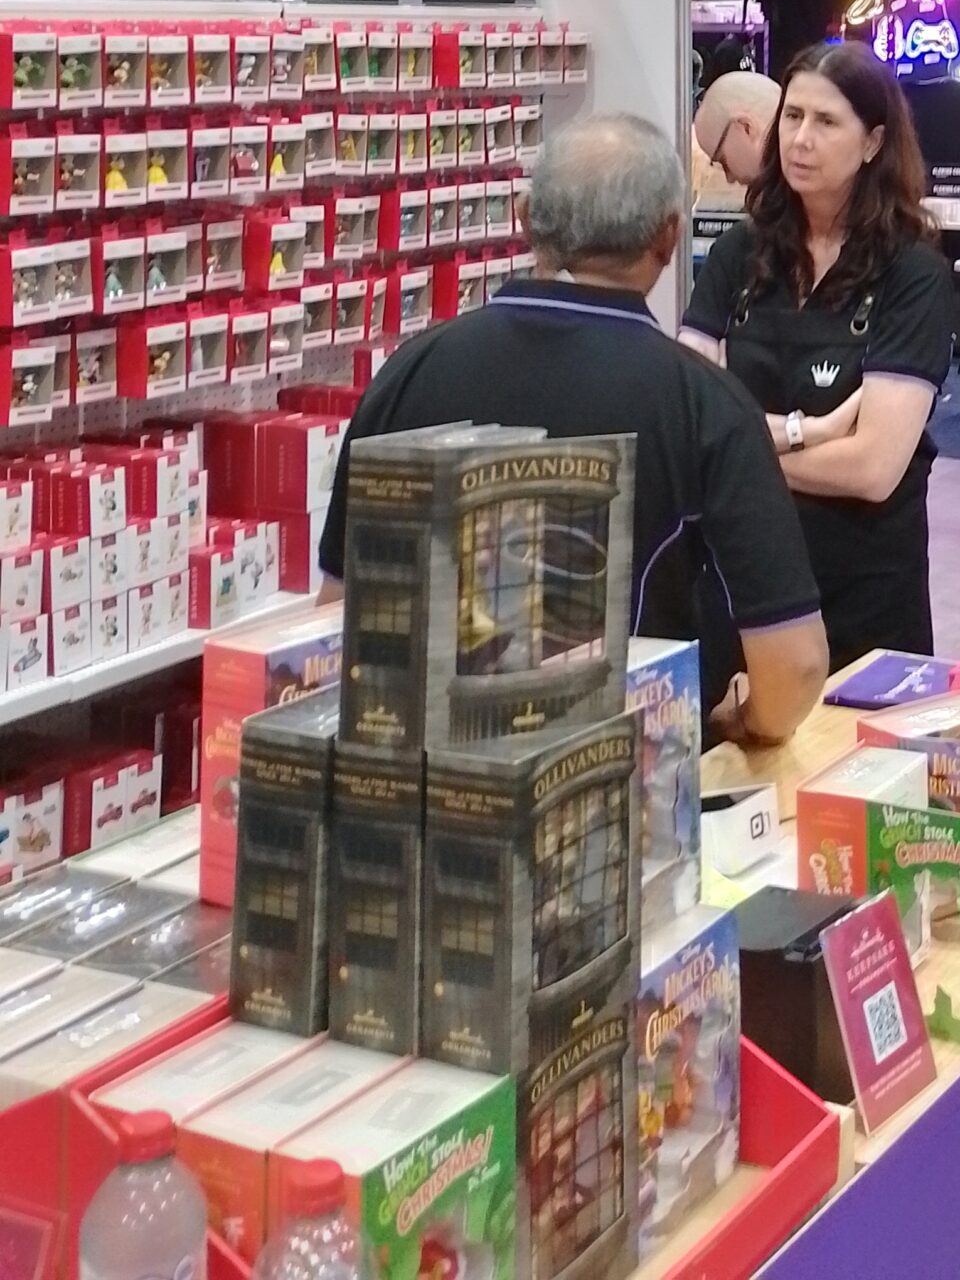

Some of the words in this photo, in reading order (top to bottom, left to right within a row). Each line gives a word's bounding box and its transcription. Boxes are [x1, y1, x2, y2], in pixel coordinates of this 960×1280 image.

[461, 457, 611, 491] OLLIVANDERS
[534, 738, 631, 800] OLLIVANDERS
[531, 1019, 624, 1103] OLLIVANDERS
[396, 1124, 494, 1237] CHRISTMAS!
